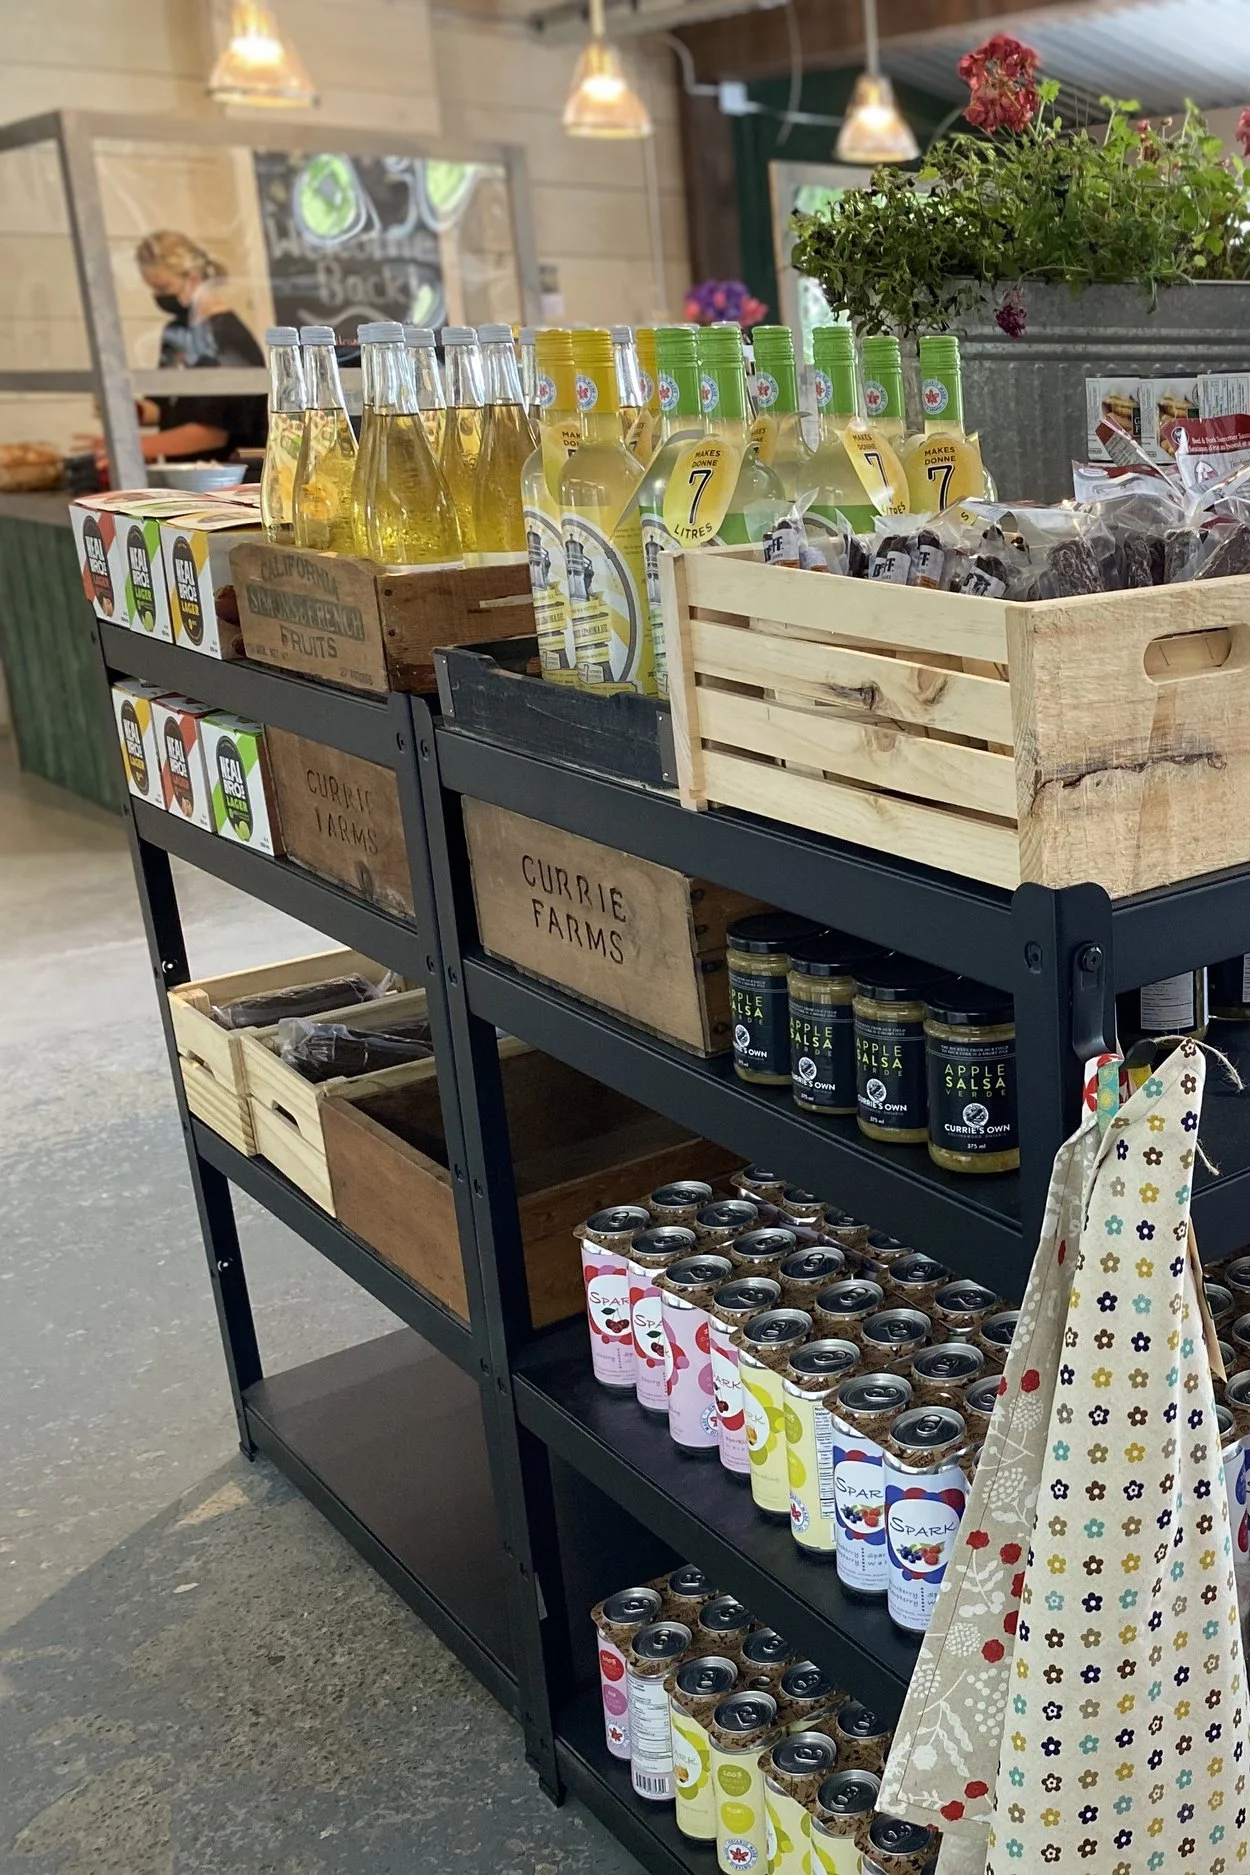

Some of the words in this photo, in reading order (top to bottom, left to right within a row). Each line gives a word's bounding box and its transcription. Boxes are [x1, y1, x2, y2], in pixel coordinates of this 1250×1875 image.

[852, 434, 873, 442] MAKES
[694, 449, 721, 458] MAKES
[857, 443, 878, 451] DONNE
[924, 446, 956, 457] MAKES
[691, 459, 719, 468] DONNE
[924, 455, 957, 466] DONNE
[864, 452, 893, 505] 7
[927, 464, 956, 511] 7
[688, 468, 714, 526] 7
[673, 522, 713, 541] LITRES
[260, 553, 341, 601] CALIFORNIA
[134, 586, 153, 602] LAGER
[180, 600, 201, 616] LAGER
[279, 623, 338, 659] FRUITS
[226, 796, 248, 812] LAGER
[521, 854, 627, 923] CURRIE
[531, 898, 624, 965] FARMS
[730, 988, 762, 1006] PPLE
[731, 1000, 763, 1018] ALSA
[789, 1027, 833, 1050] SALSA
[748, 1047, 768, 1058] OWN
[855, 1037, 902, 1057] APPLE
[856, 1049, 903, 1070] SALSA
[944, 1063, 1006, 1077] APPLE
[814, 1081, 836, 1091] OWN
[945, 1076, 1006, 1090] SALSA
[945, 1089, 1007, 1098] VERDE
[884, 1103, 907, 1113] OWN
[944, 1123, 985, 1134] CURRIE'S
[986, 1123, 1011, 1134] OWN
[889, 1516, 957, 1538] SPARK
